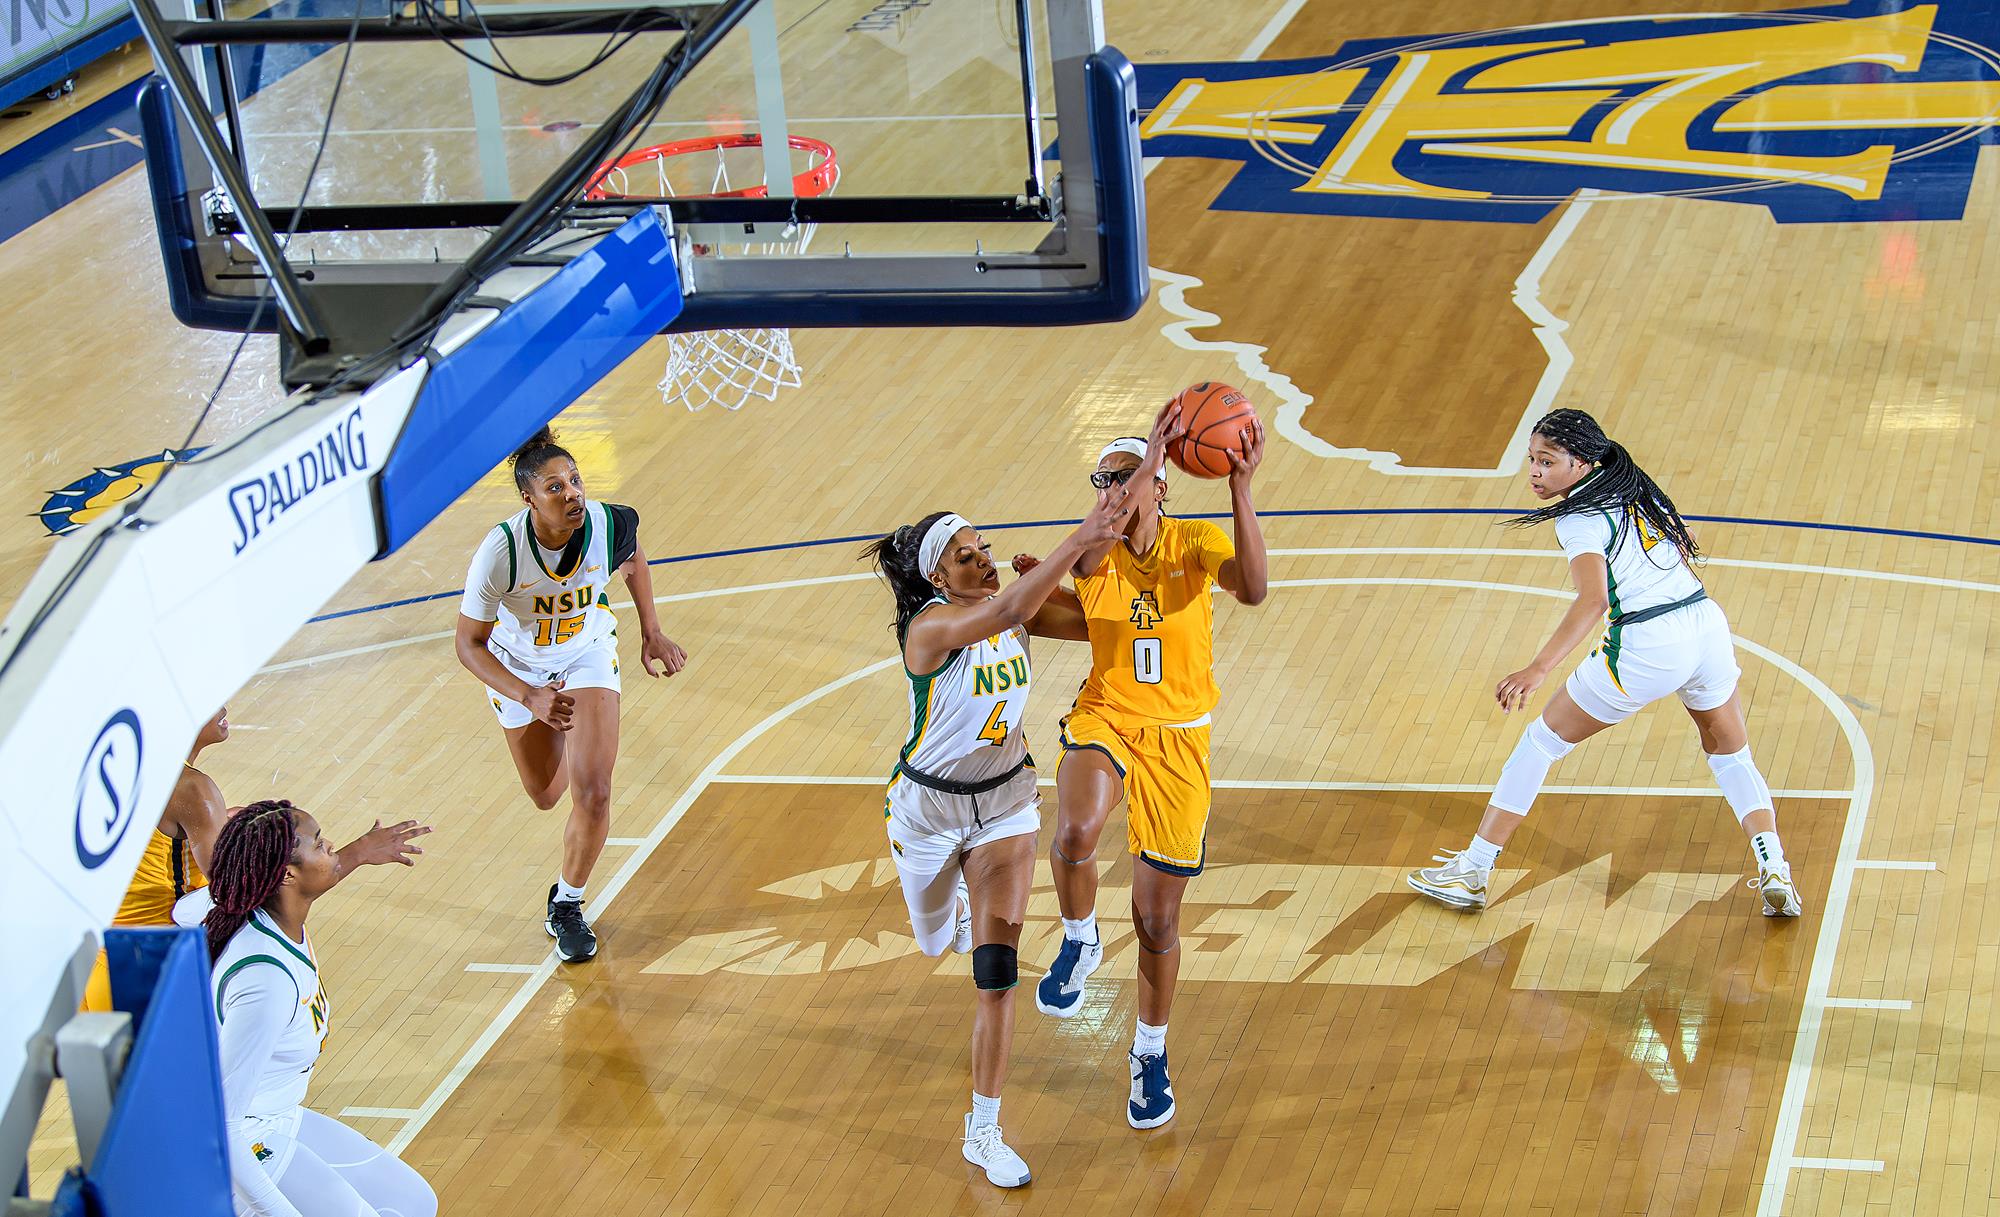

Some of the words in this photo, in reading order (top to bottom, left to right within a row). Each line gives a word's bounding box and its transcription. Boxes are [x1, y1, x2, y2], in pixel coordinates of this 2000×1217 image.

[228, 405, 368, 556] SPALDING
[532, 584, 593, 616] NSU
[533, 611, 587, 647] 15
[972, 654, 1029, 697] NSU
[1132, 637, 1163, 685] 0
[976, 699, 1009, 748] 4
